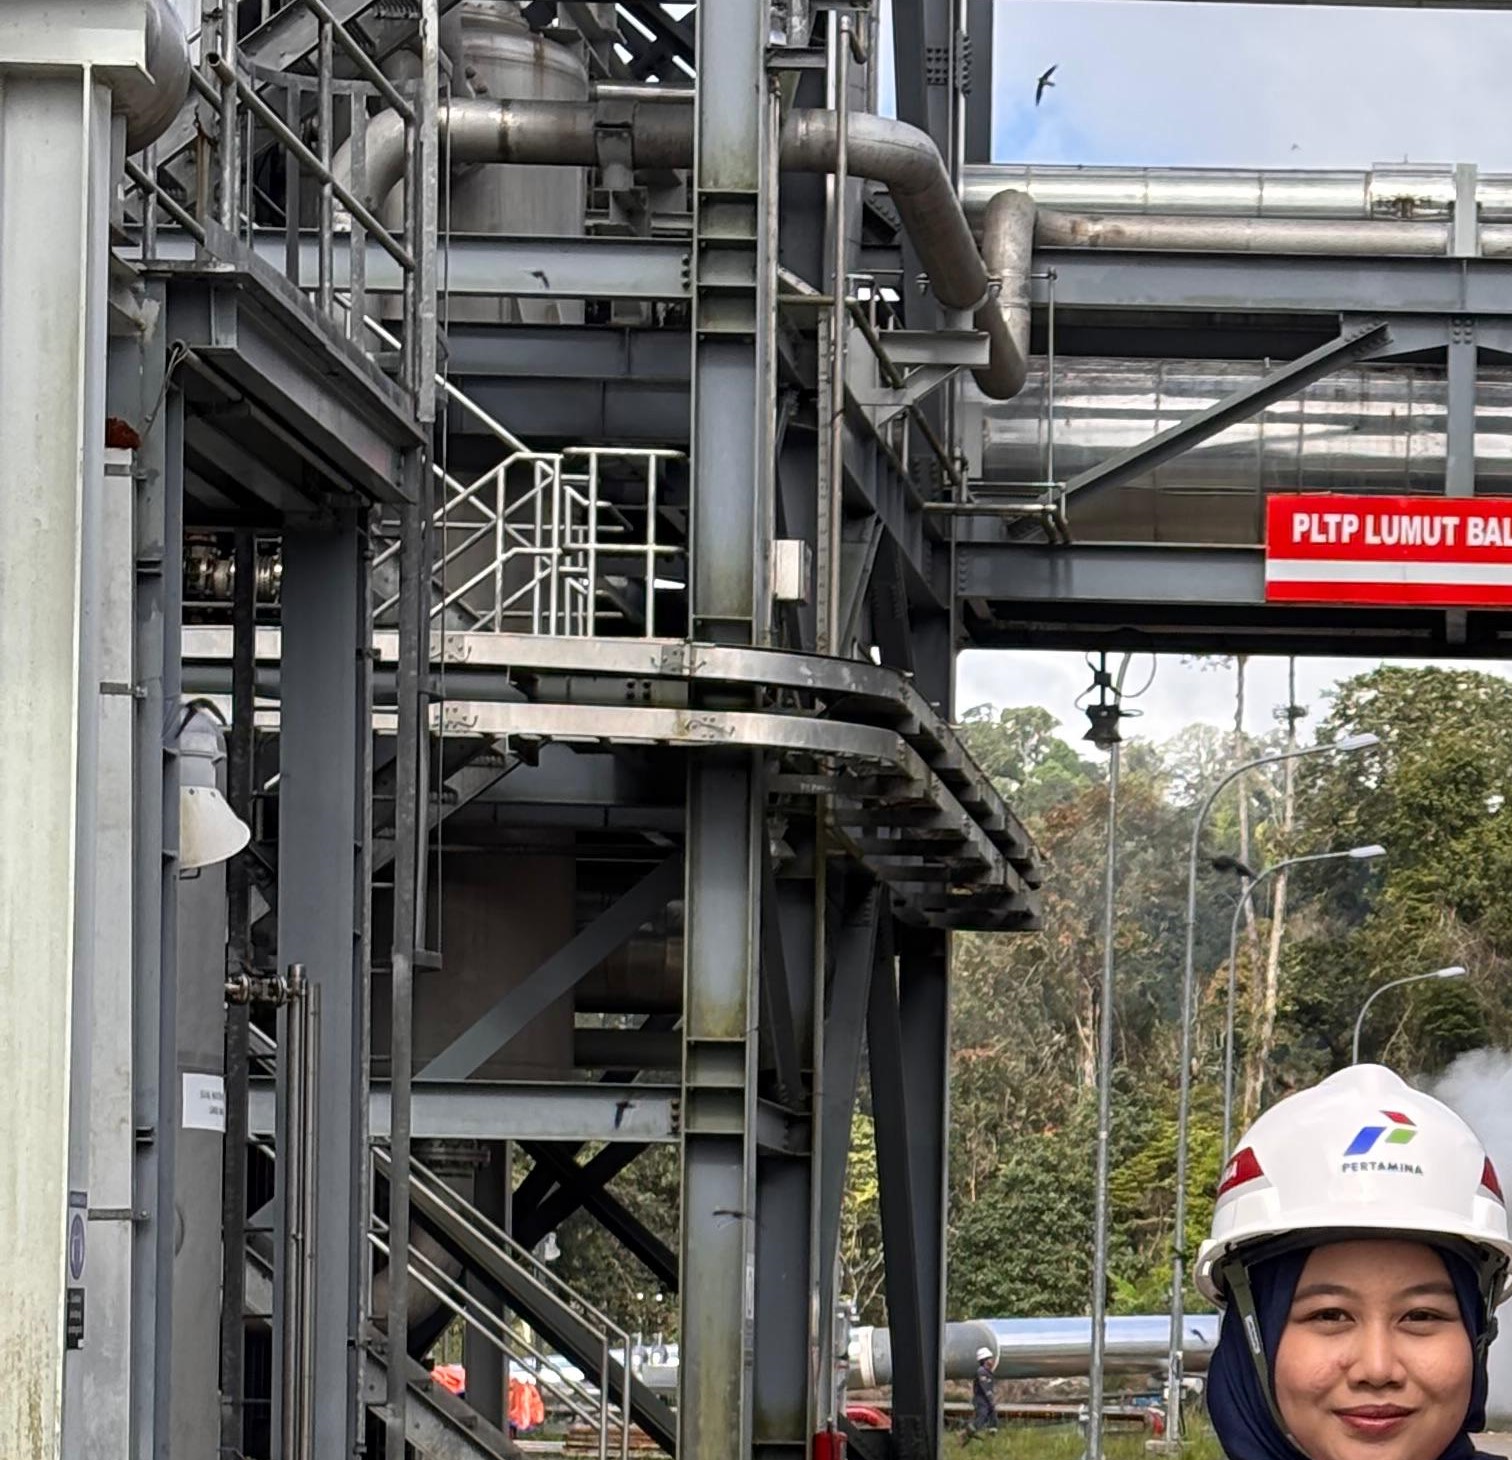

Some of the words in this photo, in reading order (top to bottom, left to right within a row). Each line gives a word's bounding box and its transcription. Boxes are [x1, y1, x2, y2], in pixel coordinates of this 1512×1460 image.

[1292, 512, 1360, 544] PLTP
[1364, 514, 1460, 546] LUMUT
[1342, 1161, 1424, 1176] PERTAMINA
